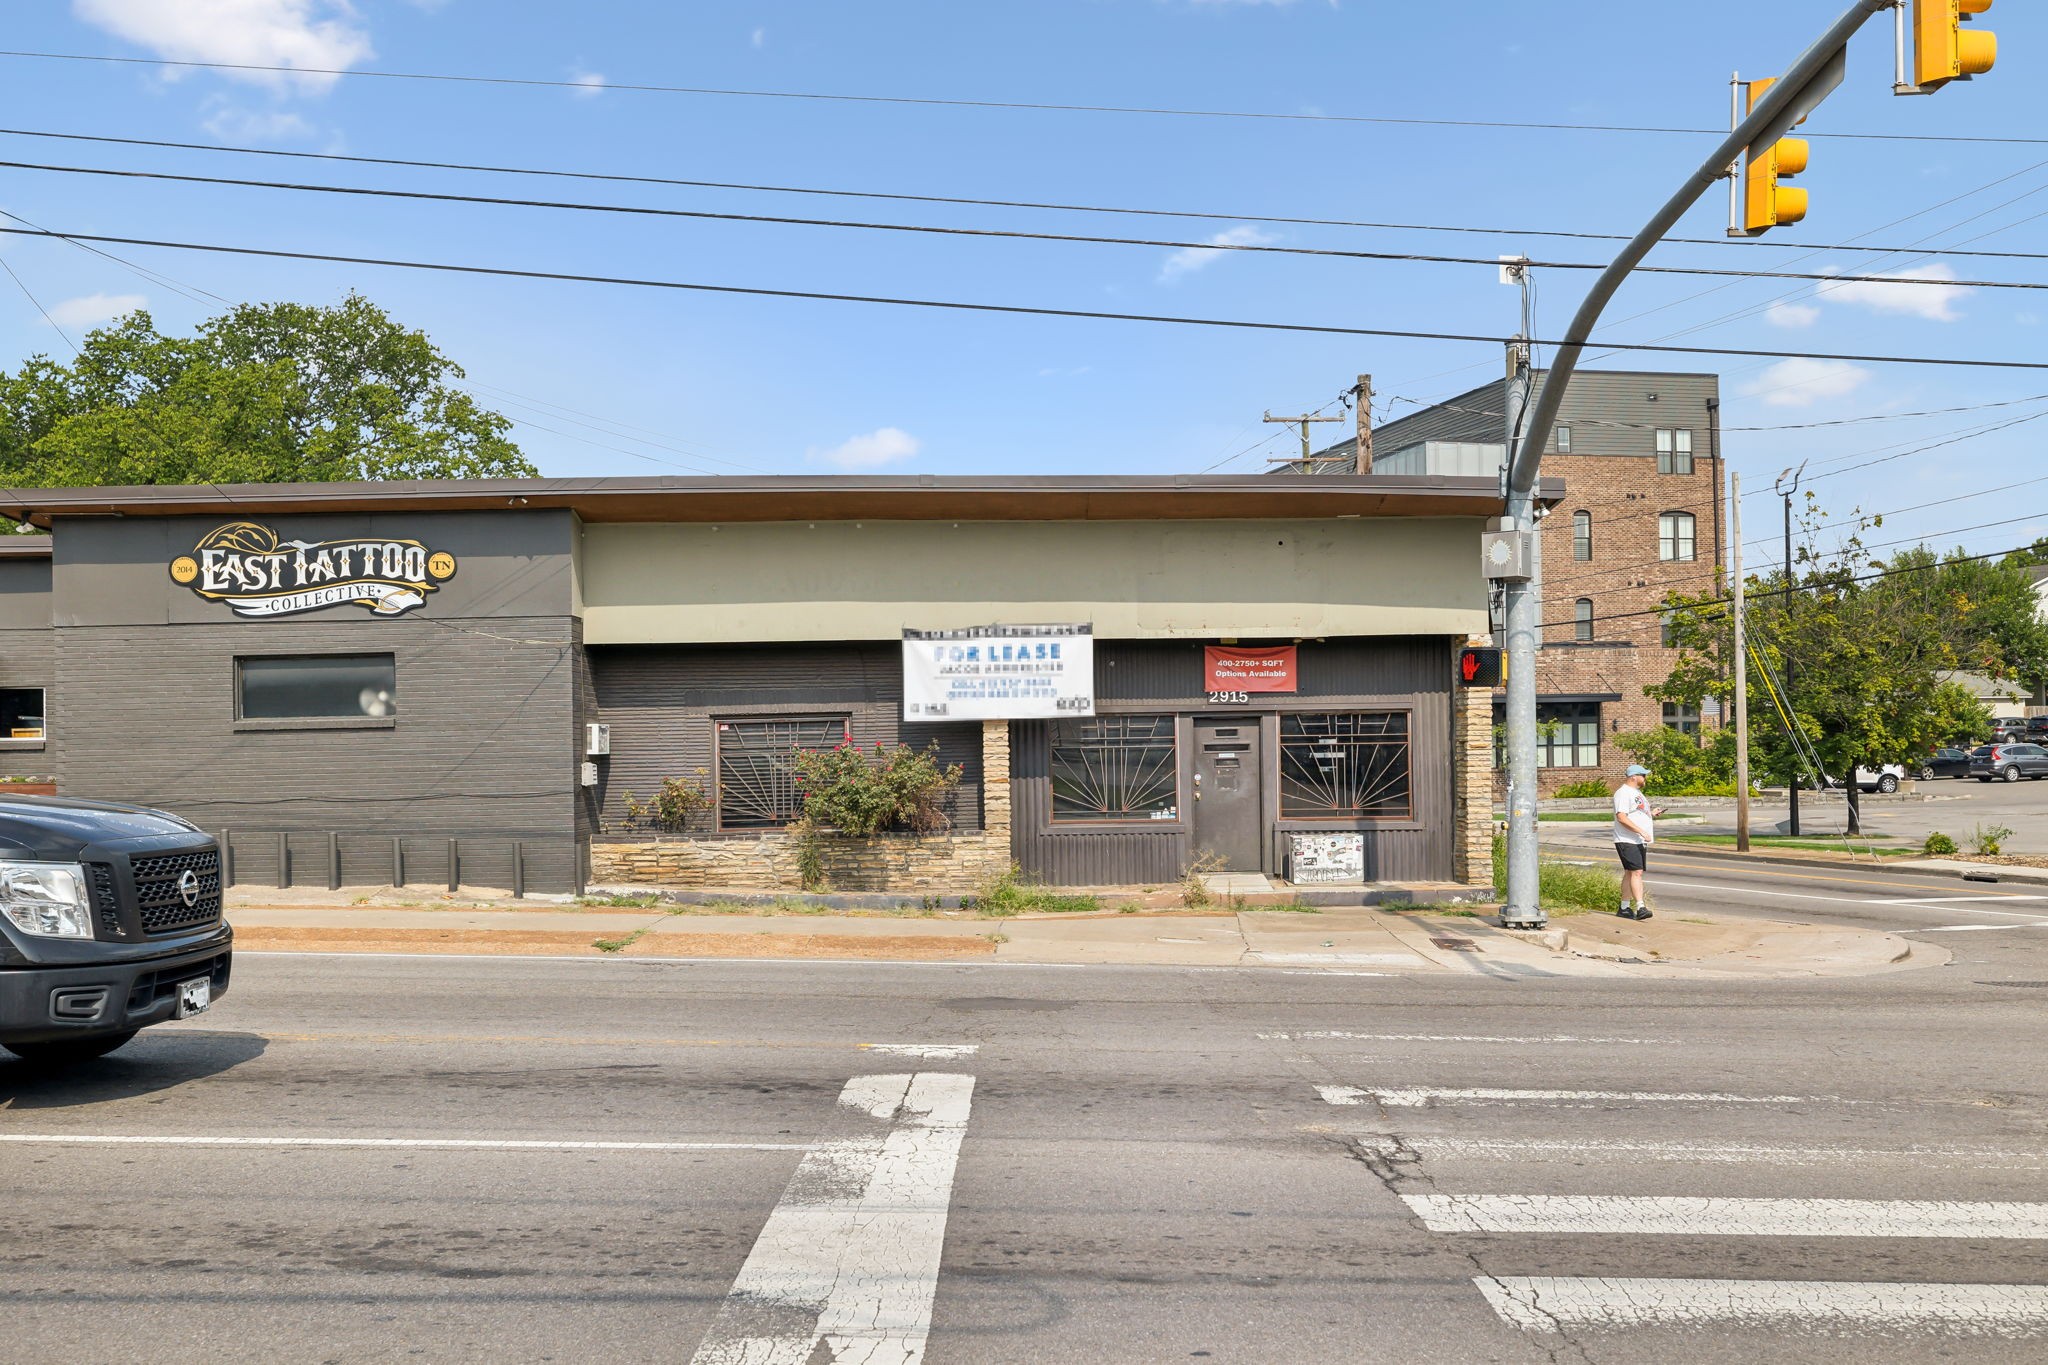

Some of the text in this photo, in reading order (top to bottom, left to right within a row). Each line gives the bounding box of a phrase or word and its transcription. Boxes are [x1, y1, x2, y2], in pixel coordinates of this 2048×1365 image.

[176, 566, 193, 574] 2014
[201, 540, 427, 592] EAST TATTOO
[433, 560, 451, 570] TN
[270, 585, 376, 612] COLLECTIVE
[988, 643, 1061, 661] LEASE
[1215, 670, 1247, 678] Options
[1209, 691, 1248, 703] 2915
